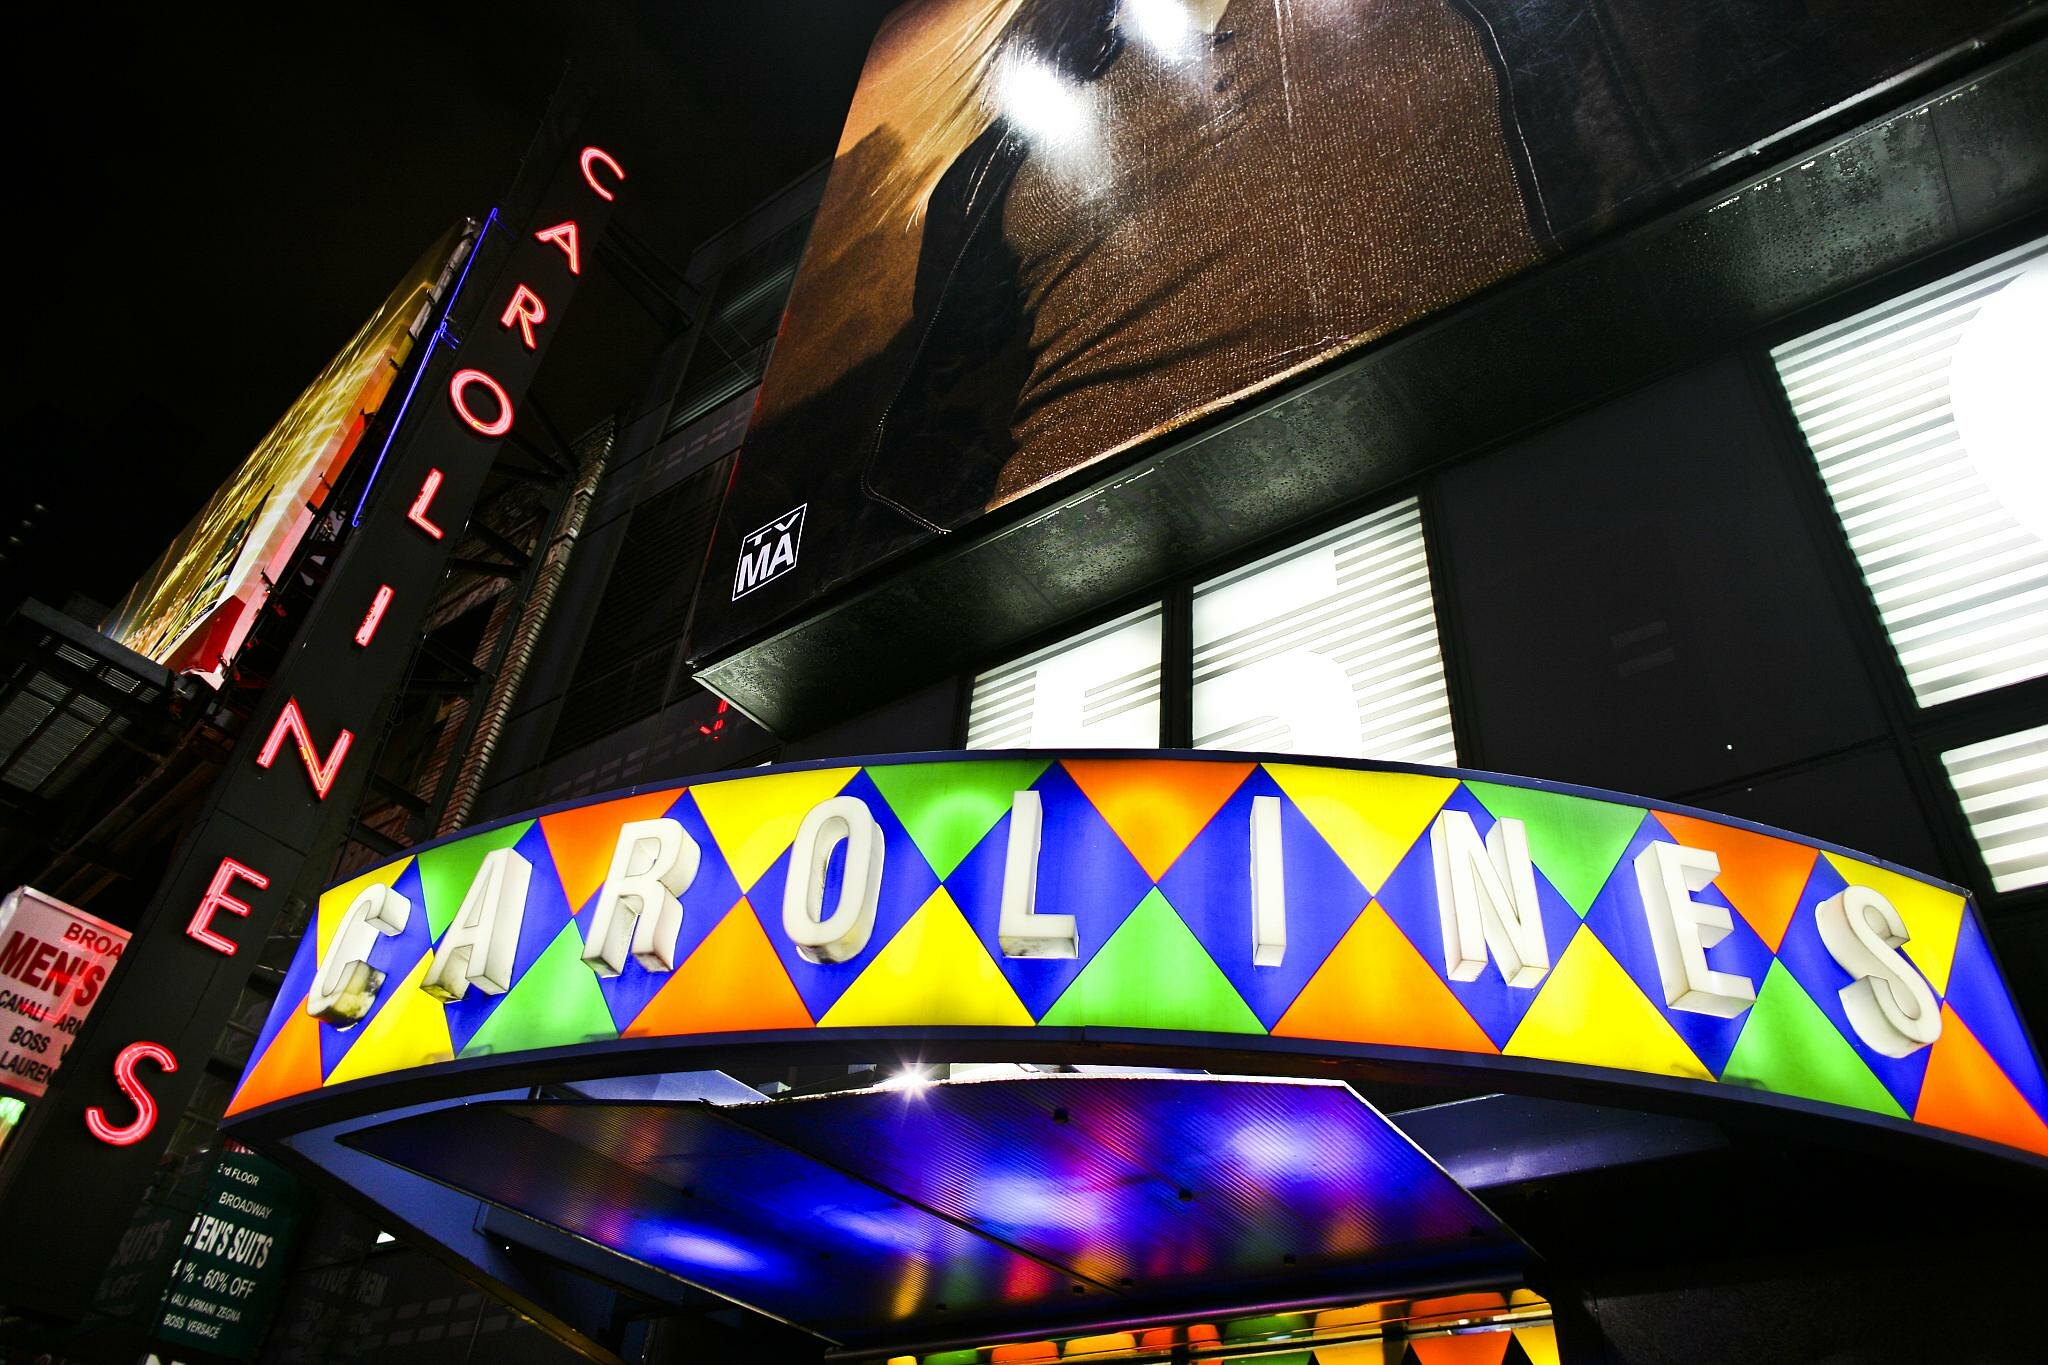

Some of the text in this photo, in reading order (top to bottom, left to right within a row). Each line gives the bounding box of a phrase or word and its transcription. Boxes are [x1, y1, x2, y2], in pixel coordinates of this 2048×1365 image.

[746, 512, 801, 547] TV
[736, 532, 794, 593] MA
[84, 146, 627, 1148] CAROLINES
[308, 788, 1945, 1060] CAROLINES
[0, 931, 105, 1007] MEN'S
[0, 989, 51, 1022] CANALI
[8, 1025, 51, 1054] BOSS
[230, 1168, 260, 1187] FLOOR
[218, 1191, 273, 1220] BROADWAY
[229, 1227, 273, 1269] SUITS
[203, 1269, 228, 1293] 60%
[229, 1277, 256, 1300] OFF
[163, 1313, 185, 1330] BOSS
[187, 1297, 216, 1315] ARMANI
[217, 1305, 241, 1322] ZEGNA
